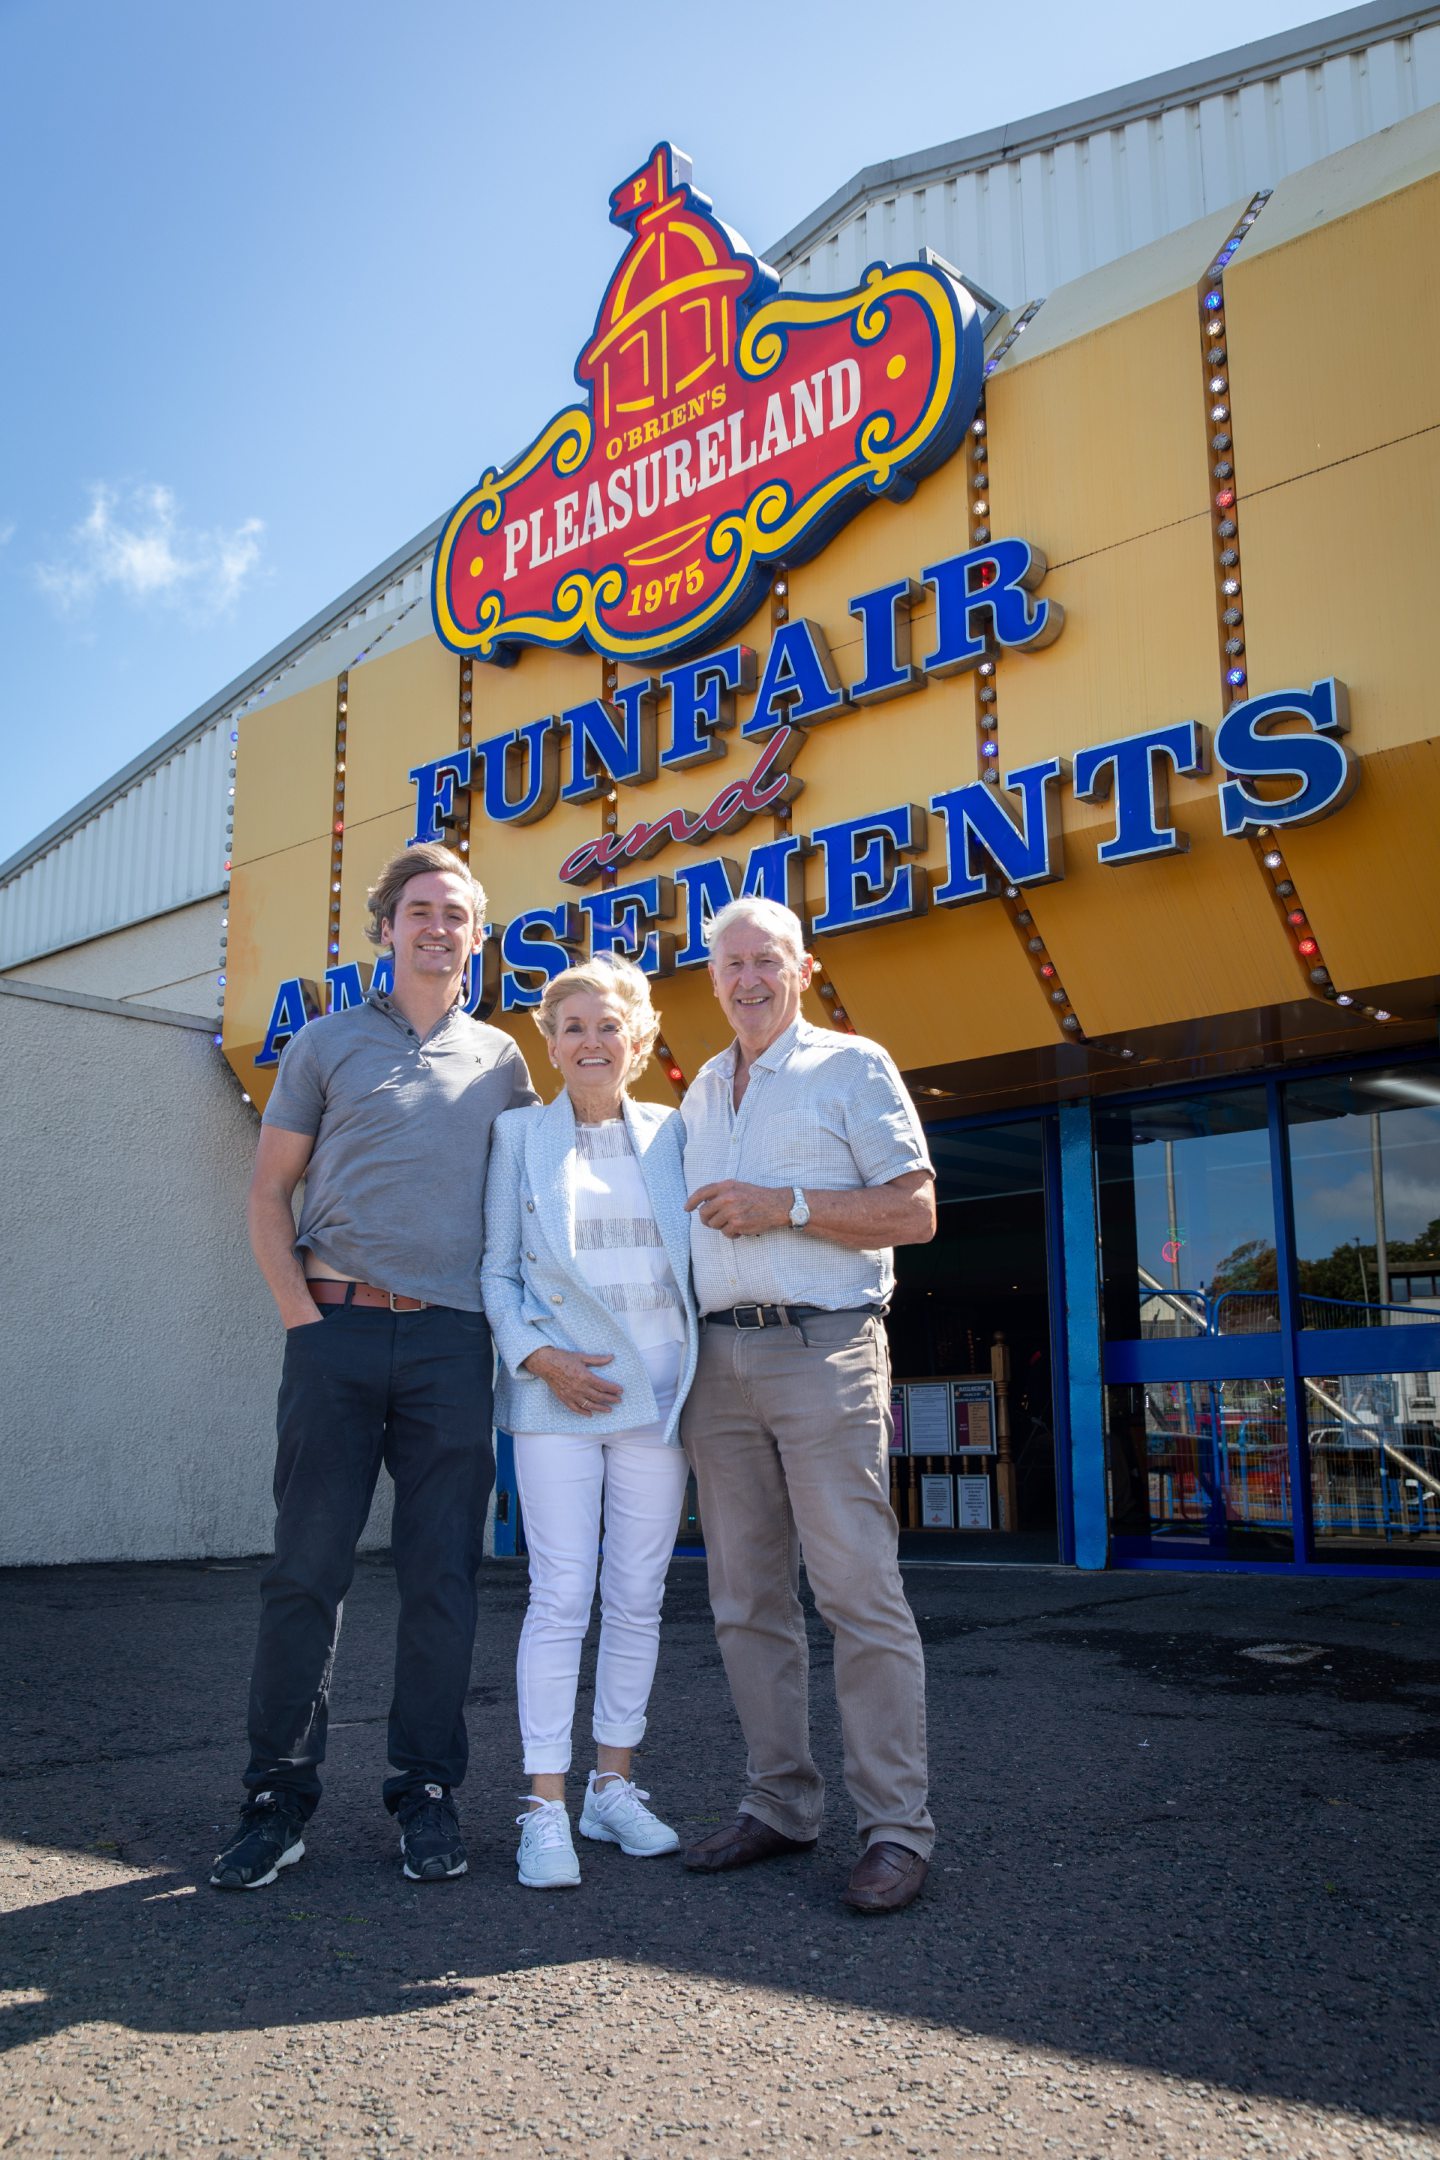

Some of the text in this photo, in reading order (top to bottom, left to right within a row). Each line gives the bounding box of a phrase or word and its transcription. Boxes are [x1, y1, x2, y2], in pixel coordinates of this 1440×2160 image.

[503, 358, 862, 582] PLEASURELAND
[605, 383, 727, 461] O'BRIEN'S
[627, 558, 705, 618] 1975
[405, 537, 1053, 849] FUNFAIR
[558, 725, 792, 883] and
